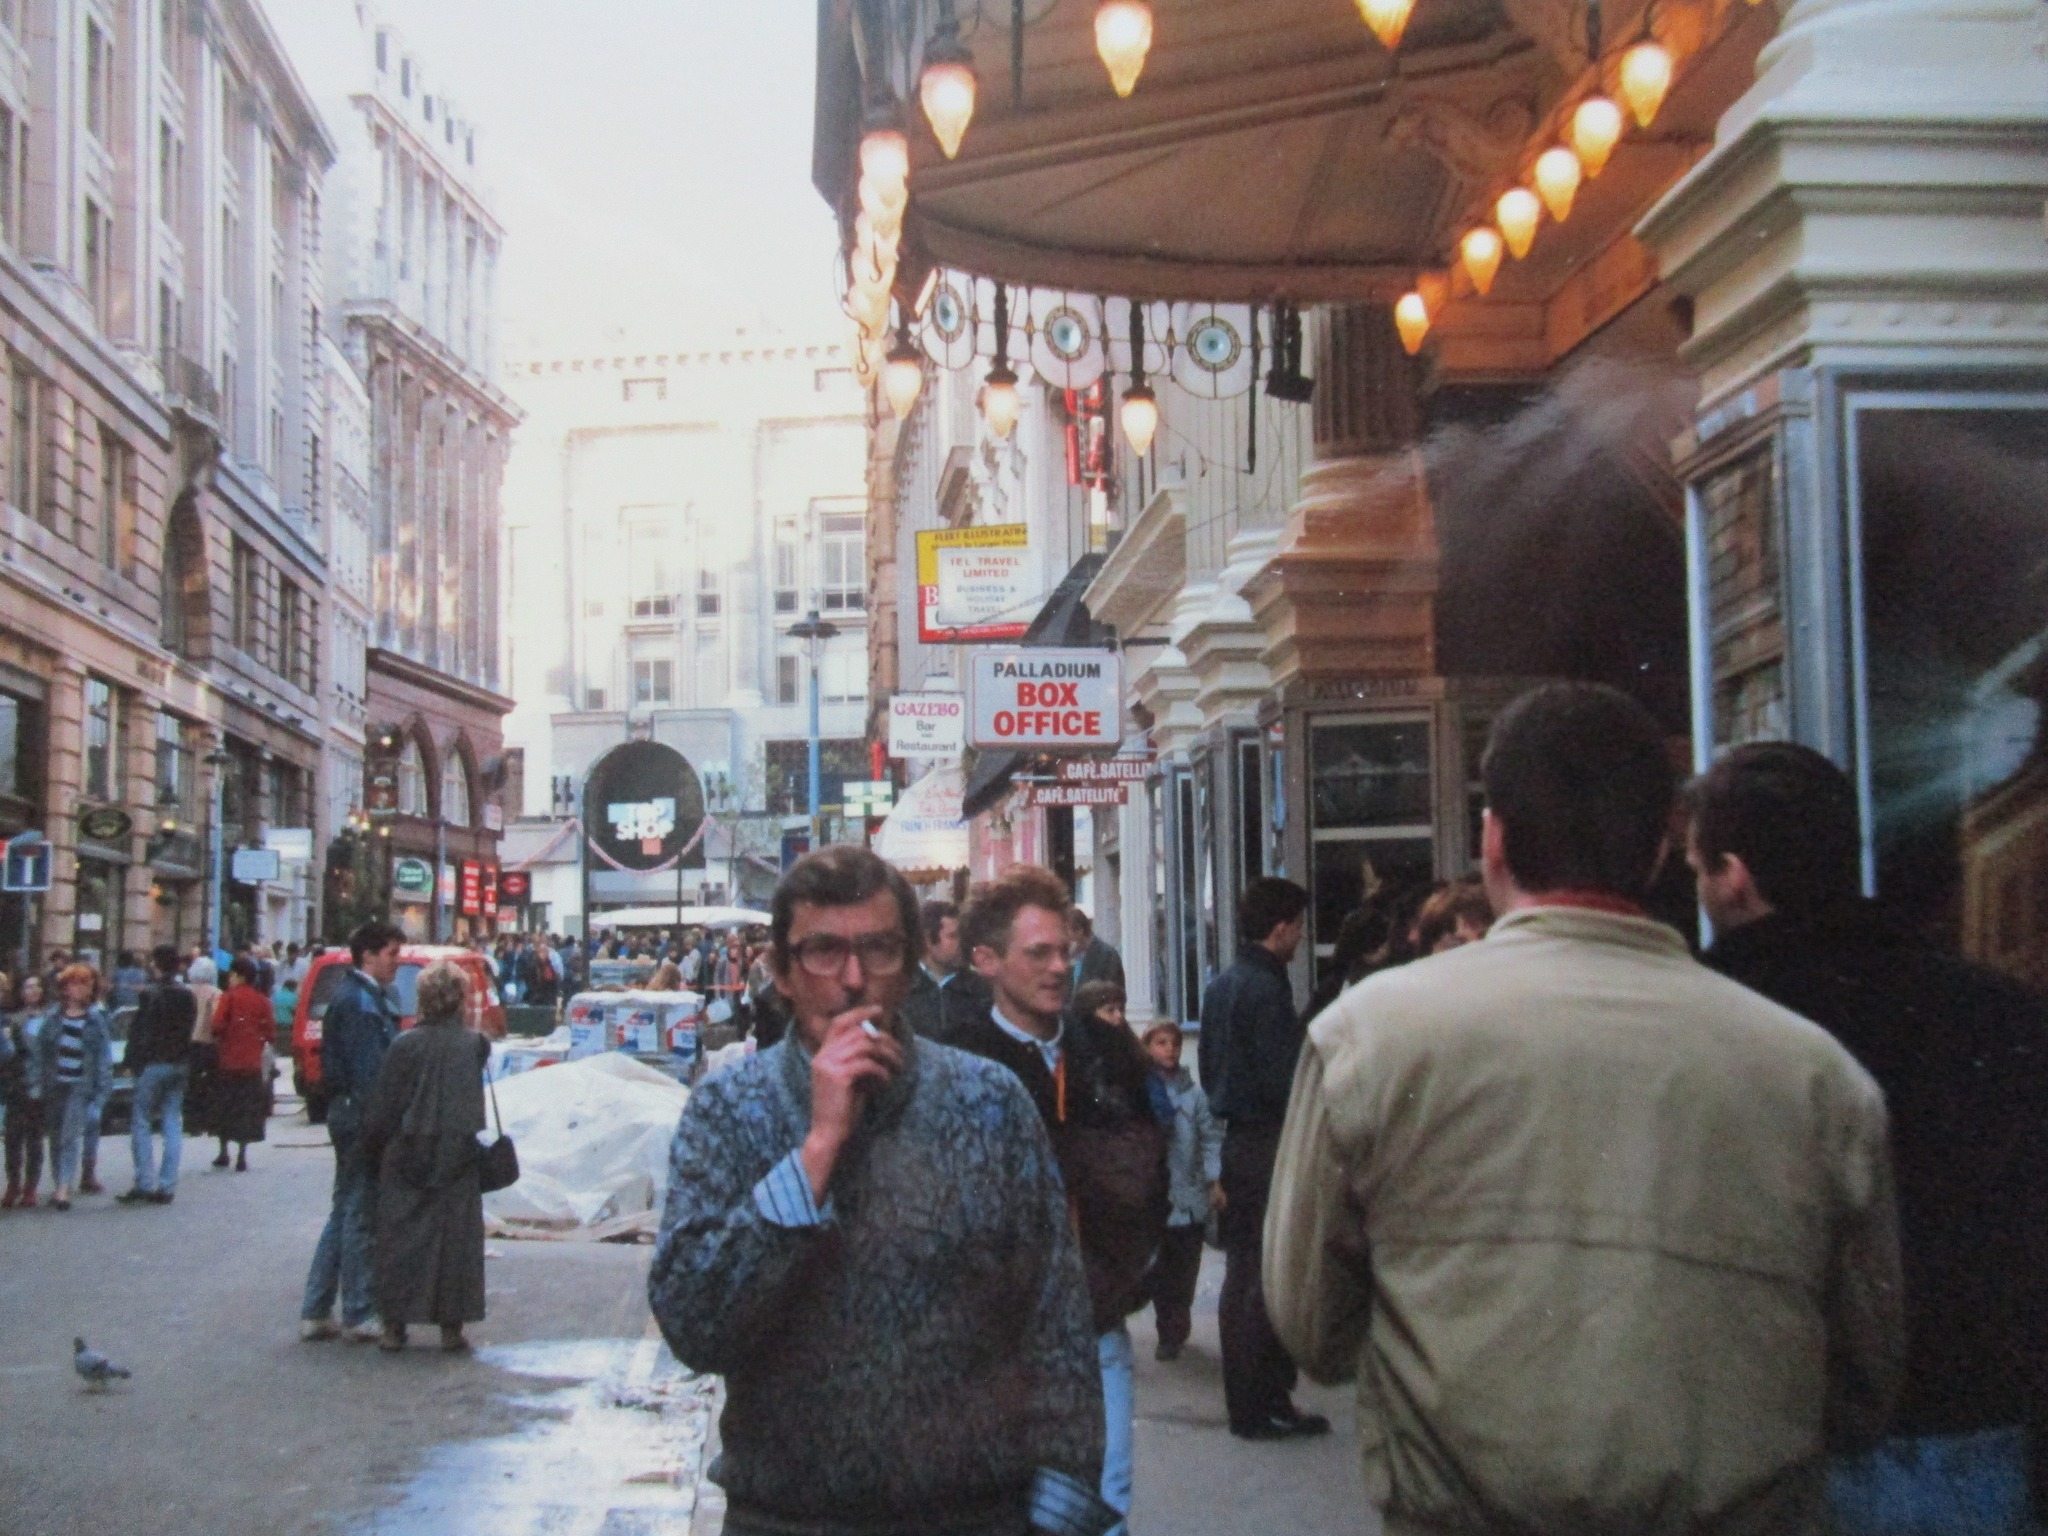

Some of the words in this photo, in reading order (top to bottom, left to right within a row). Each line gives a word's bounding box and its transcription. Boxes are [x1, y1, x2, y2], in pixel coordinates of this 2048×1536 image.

[978, 556, 1020, 567] TRAVEL
[963, 569, 1009, 578] LIMITED
[956, 585, 1005, 593] BUSINESS
[993, 662, 1101, 678] PALLADIUM
[1017, 681, 1079, 707] BOX
[895, 702, 960, 717] GAZEBO
[916, 719, 935, 732] Bar
[993, 710, 1101, 736] OFFICE
[896, 739, 957, 752] Restaurant
